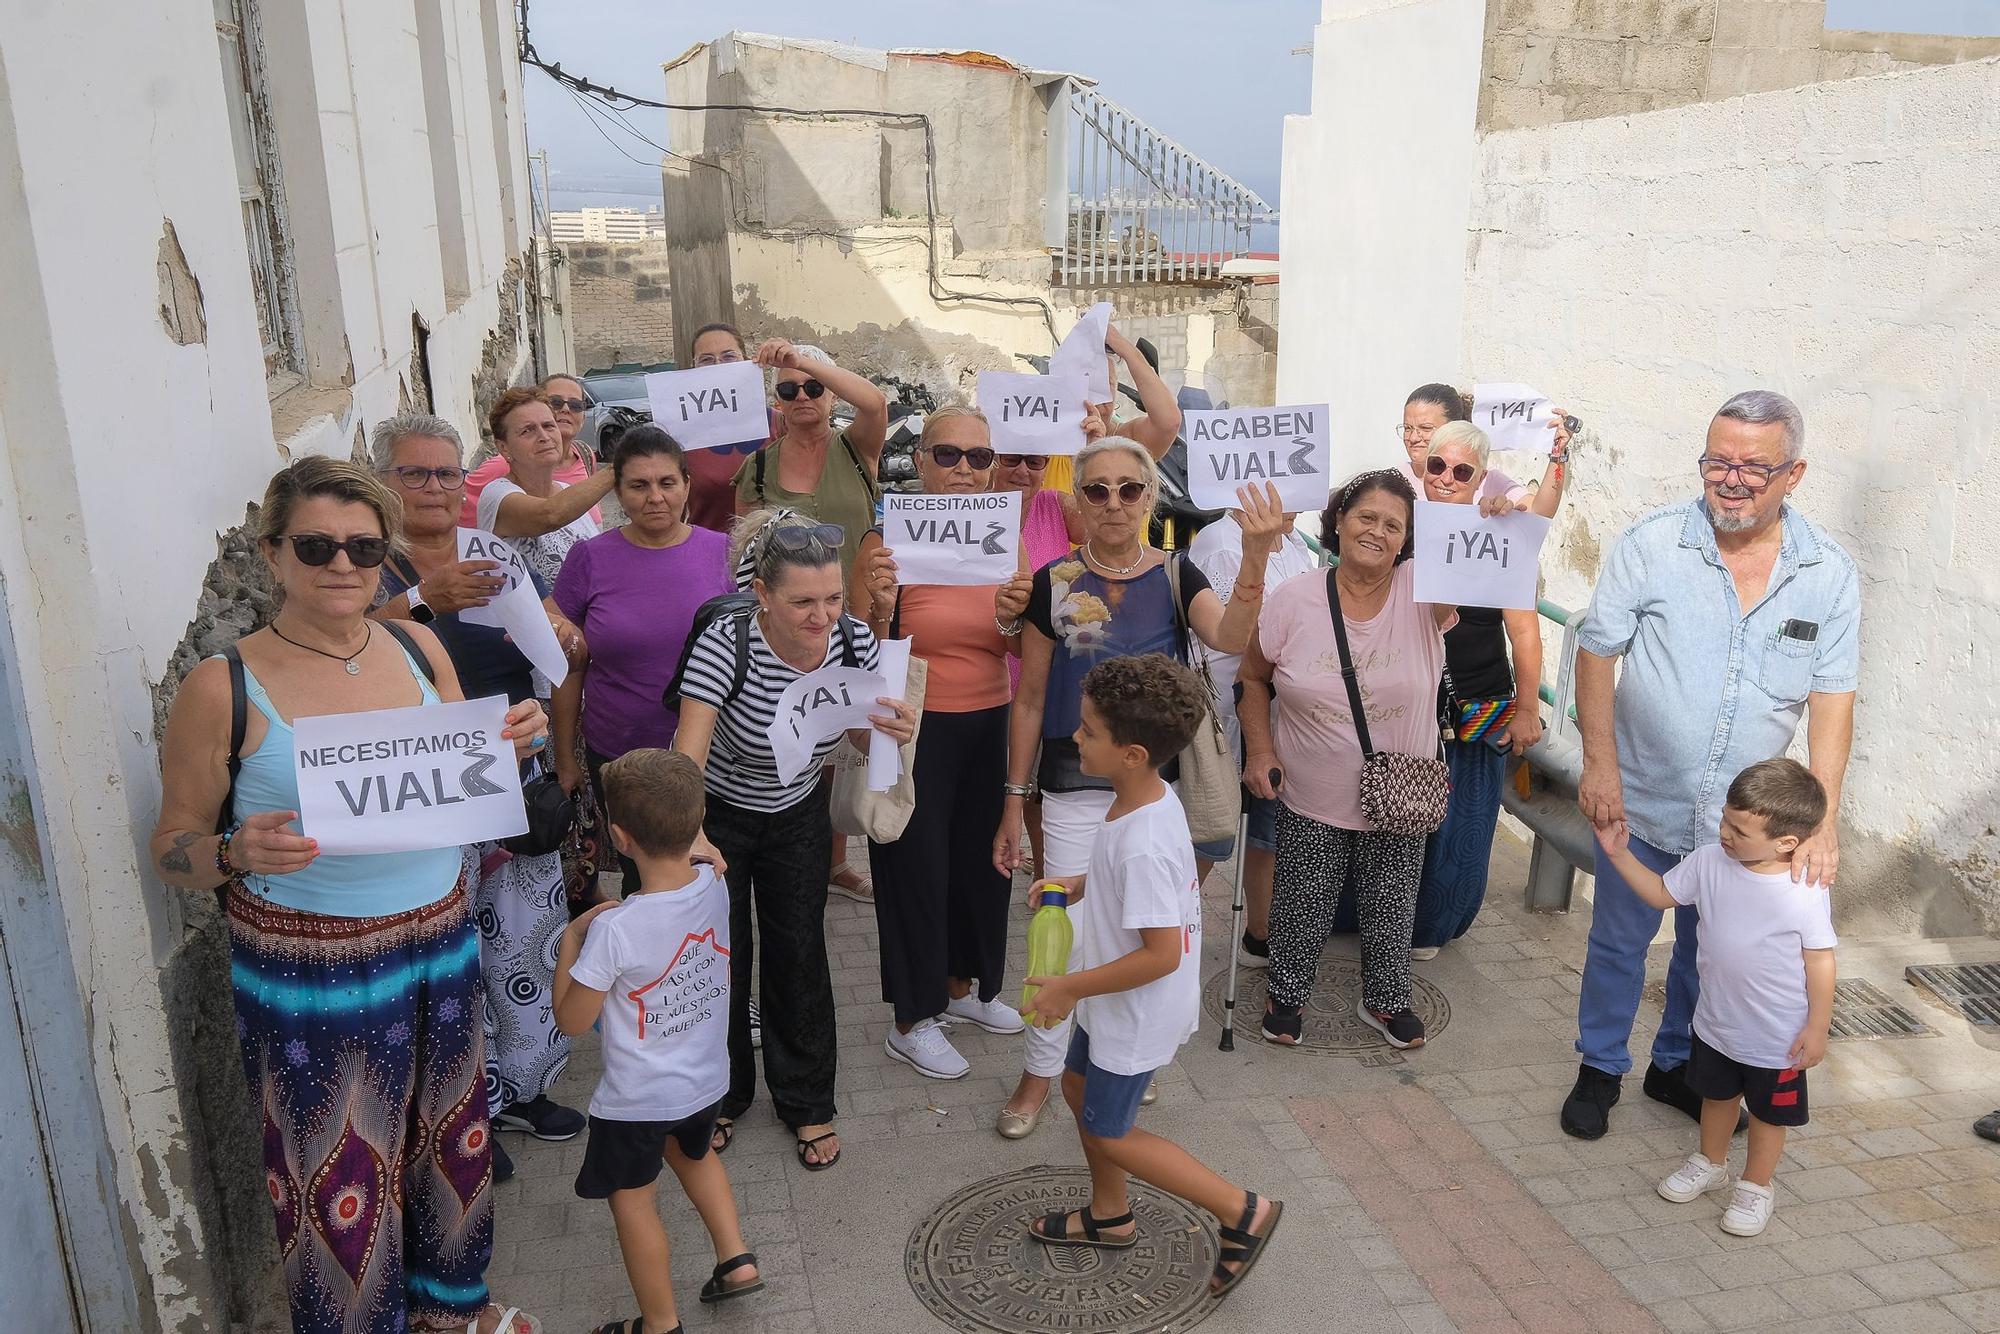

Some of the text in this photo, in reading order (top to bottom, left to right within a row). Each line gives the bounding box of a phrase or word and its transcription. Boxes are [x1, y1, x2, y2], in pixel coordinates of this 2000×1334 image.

[1193, 411, 1314, 441] ACABEN
[1208, 450, 1290, 481] VIAL
[889, 496, 1008, 511] NECESITAMOS
[904, 519, 980, 545] VIAL
[464, 536, 525, 575] ACA
[299, 729, 488, 769] NECESITAMOS
[334, 768, 466, 818] VIAL
[679, 942, 702, 966] QUÉ
[658, 957, 713, 989] PASA CON
[682, 975, 714, 996] CASA
[646, 984, 727, 1025] DE NUESTROS
[657, 1008, 712, 1040] ABUELOS
[993, 1186, 1063, 1210] PALMAS
[1068, 1186, 1090, 1198] DE
